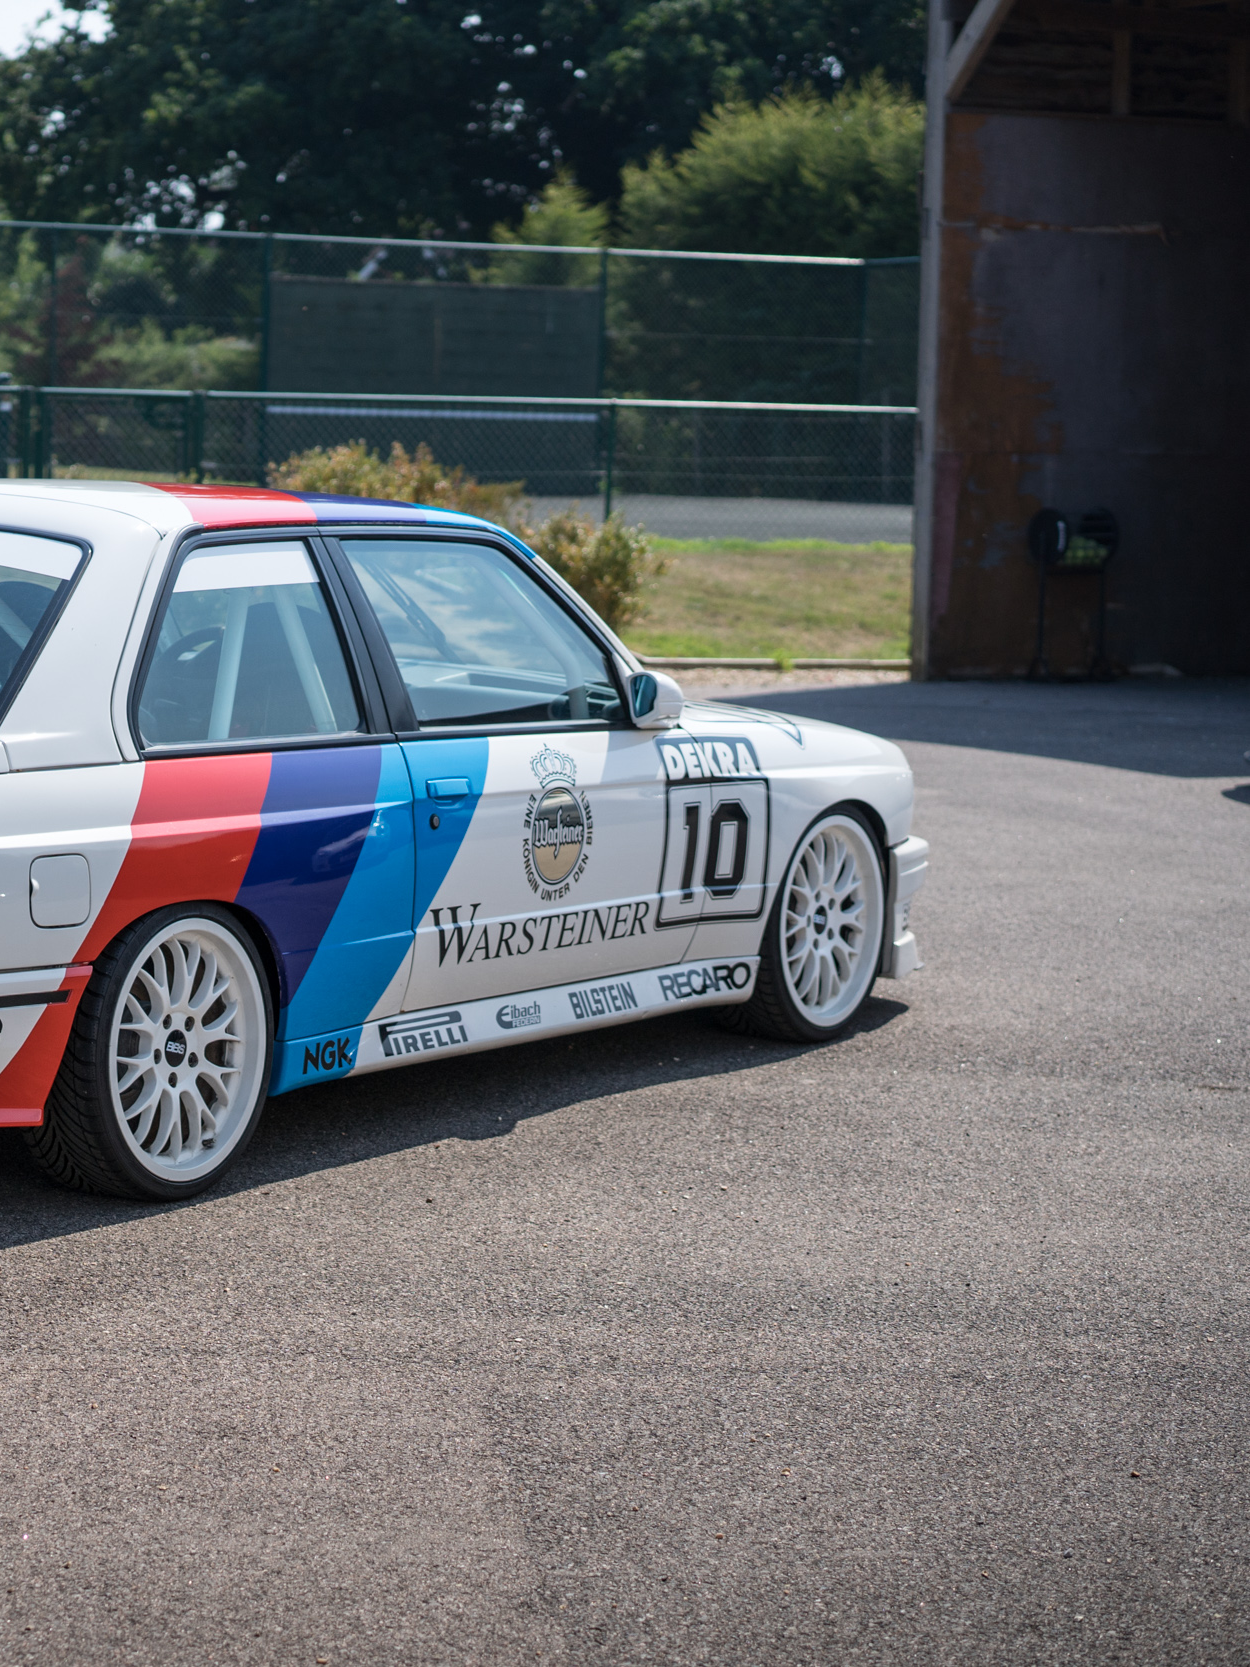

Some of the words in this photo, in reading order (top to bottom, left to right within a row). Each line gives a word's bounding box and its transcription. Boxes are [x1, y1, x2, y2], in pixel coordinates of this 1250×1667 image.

[659, 741, 765, 781] DEKRA
[523, 793, 537, 830] EINE
[522, 837, 540, 894] KÖNIGIN
[573, 853, 589, 883] DEN
[679, 798, 751, 905] 10
[540, 882, 570, 902] UNTER
[429, 901, 650, 968] WARSTEINER
[567, 981, 638, 1020] BILSTEIN
[657, 961, 751, 1001] RECARO
[377, 1010, 469, 1058] PIRELLI
[495, 1000, 541, 1029] Eibach
[511, 1014, 541, 1028] FEDERN
[165, 1041, 186, 1055] BBS
[302, 1036, 353, 1075] NGK
